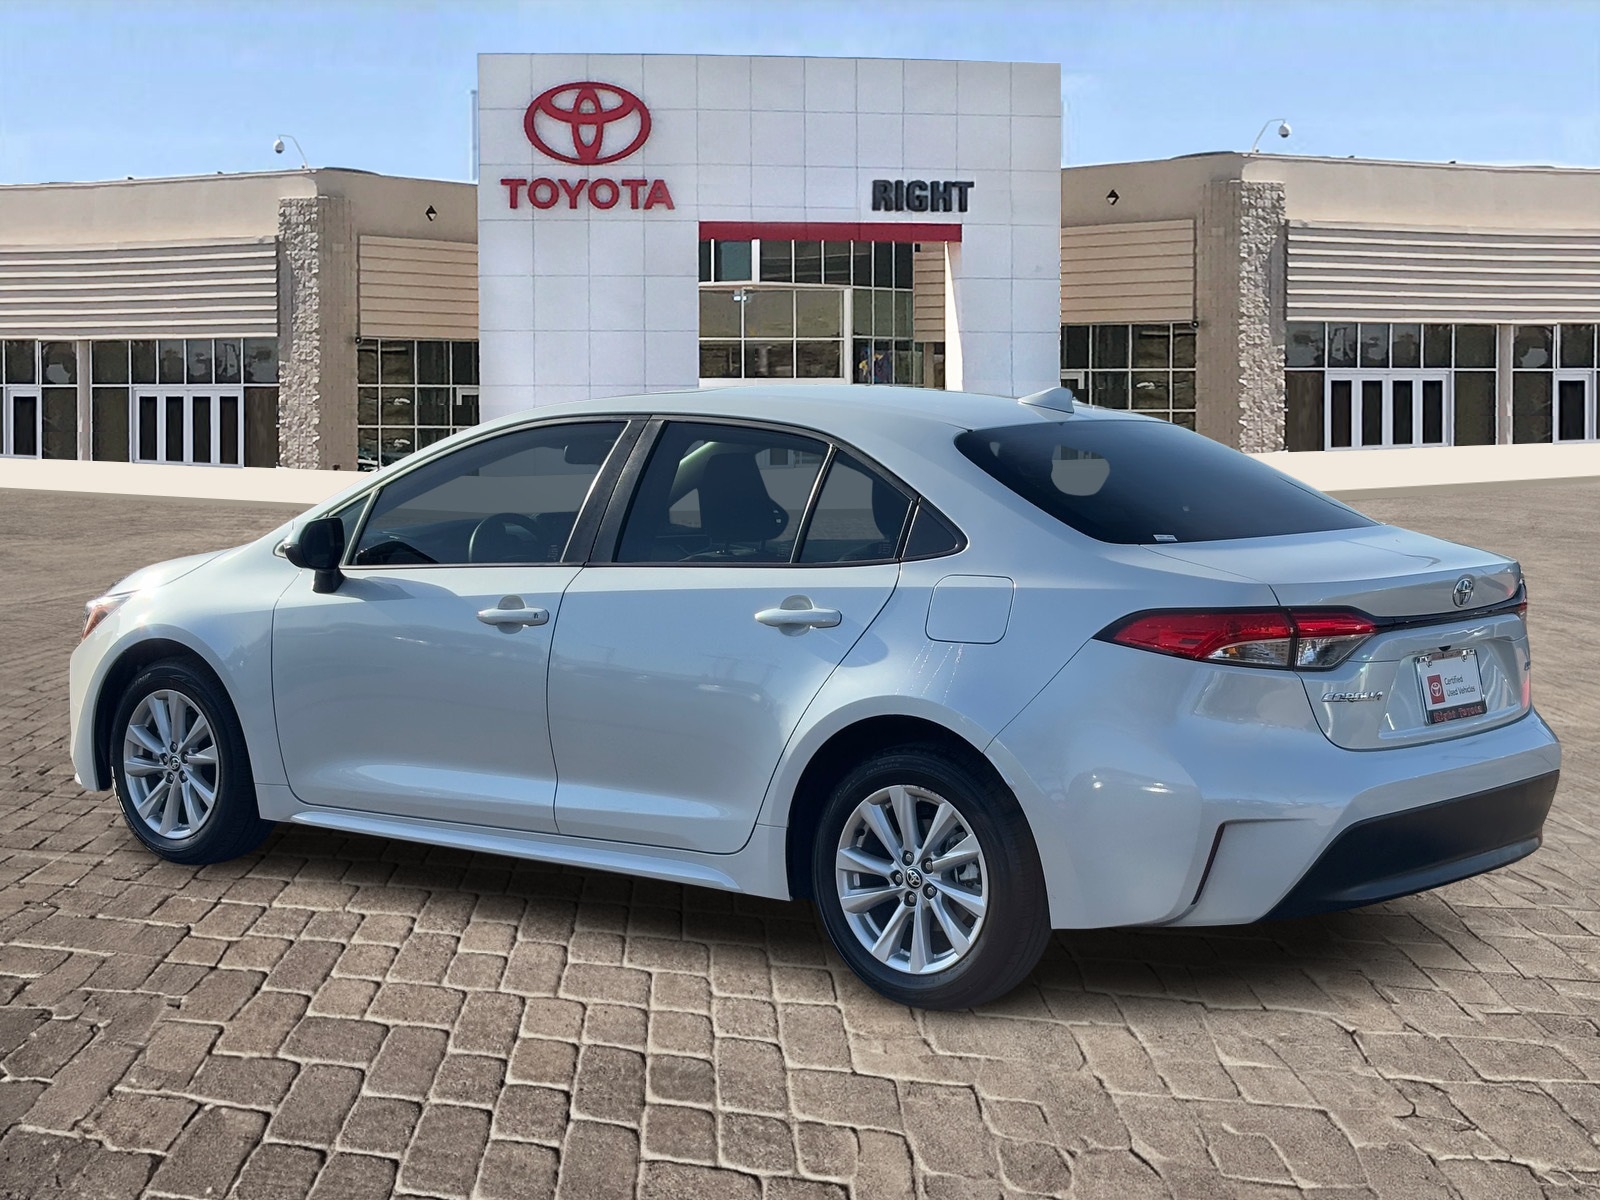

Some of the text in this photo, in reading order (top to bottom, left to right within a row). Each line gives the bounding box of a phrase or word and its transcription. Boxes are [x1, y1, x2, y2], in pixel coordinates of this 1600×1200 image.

[500, 177, 675, 210] TOYOTA
[872, 180, 975, 212] RIGHT
[1444, 675, 1464, 686] Certified
[1446, 685, 1476, 697] Used Vehicles
[1434, 710, 1457, 722] Right
